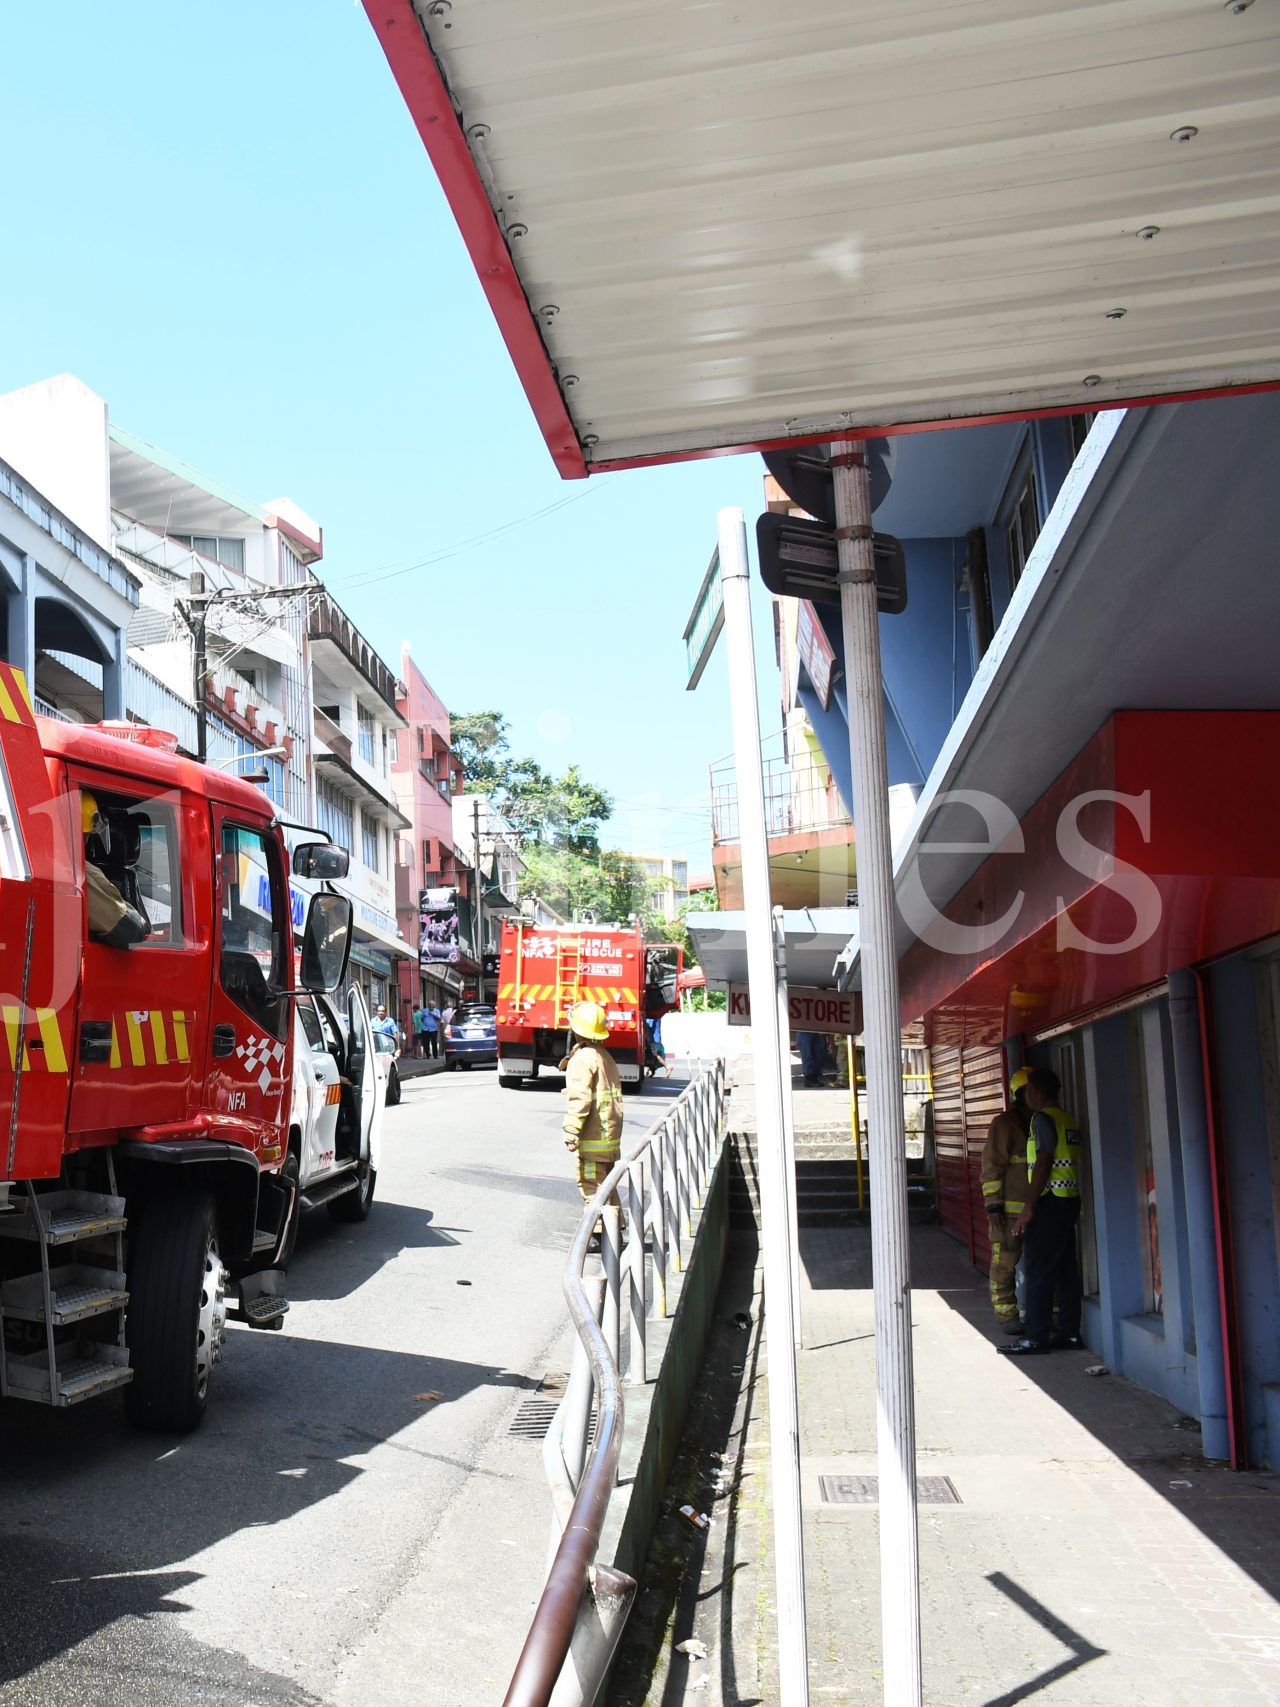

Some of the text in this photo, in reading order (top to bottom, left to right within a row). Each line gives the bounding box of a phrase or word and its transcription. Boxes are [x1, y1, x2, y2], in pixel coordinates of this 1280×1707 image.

[521, 948, 545, 958] NFA
[788, 998, 851, 1024] STORE
[228, 1091, 246, 1111] NFA
